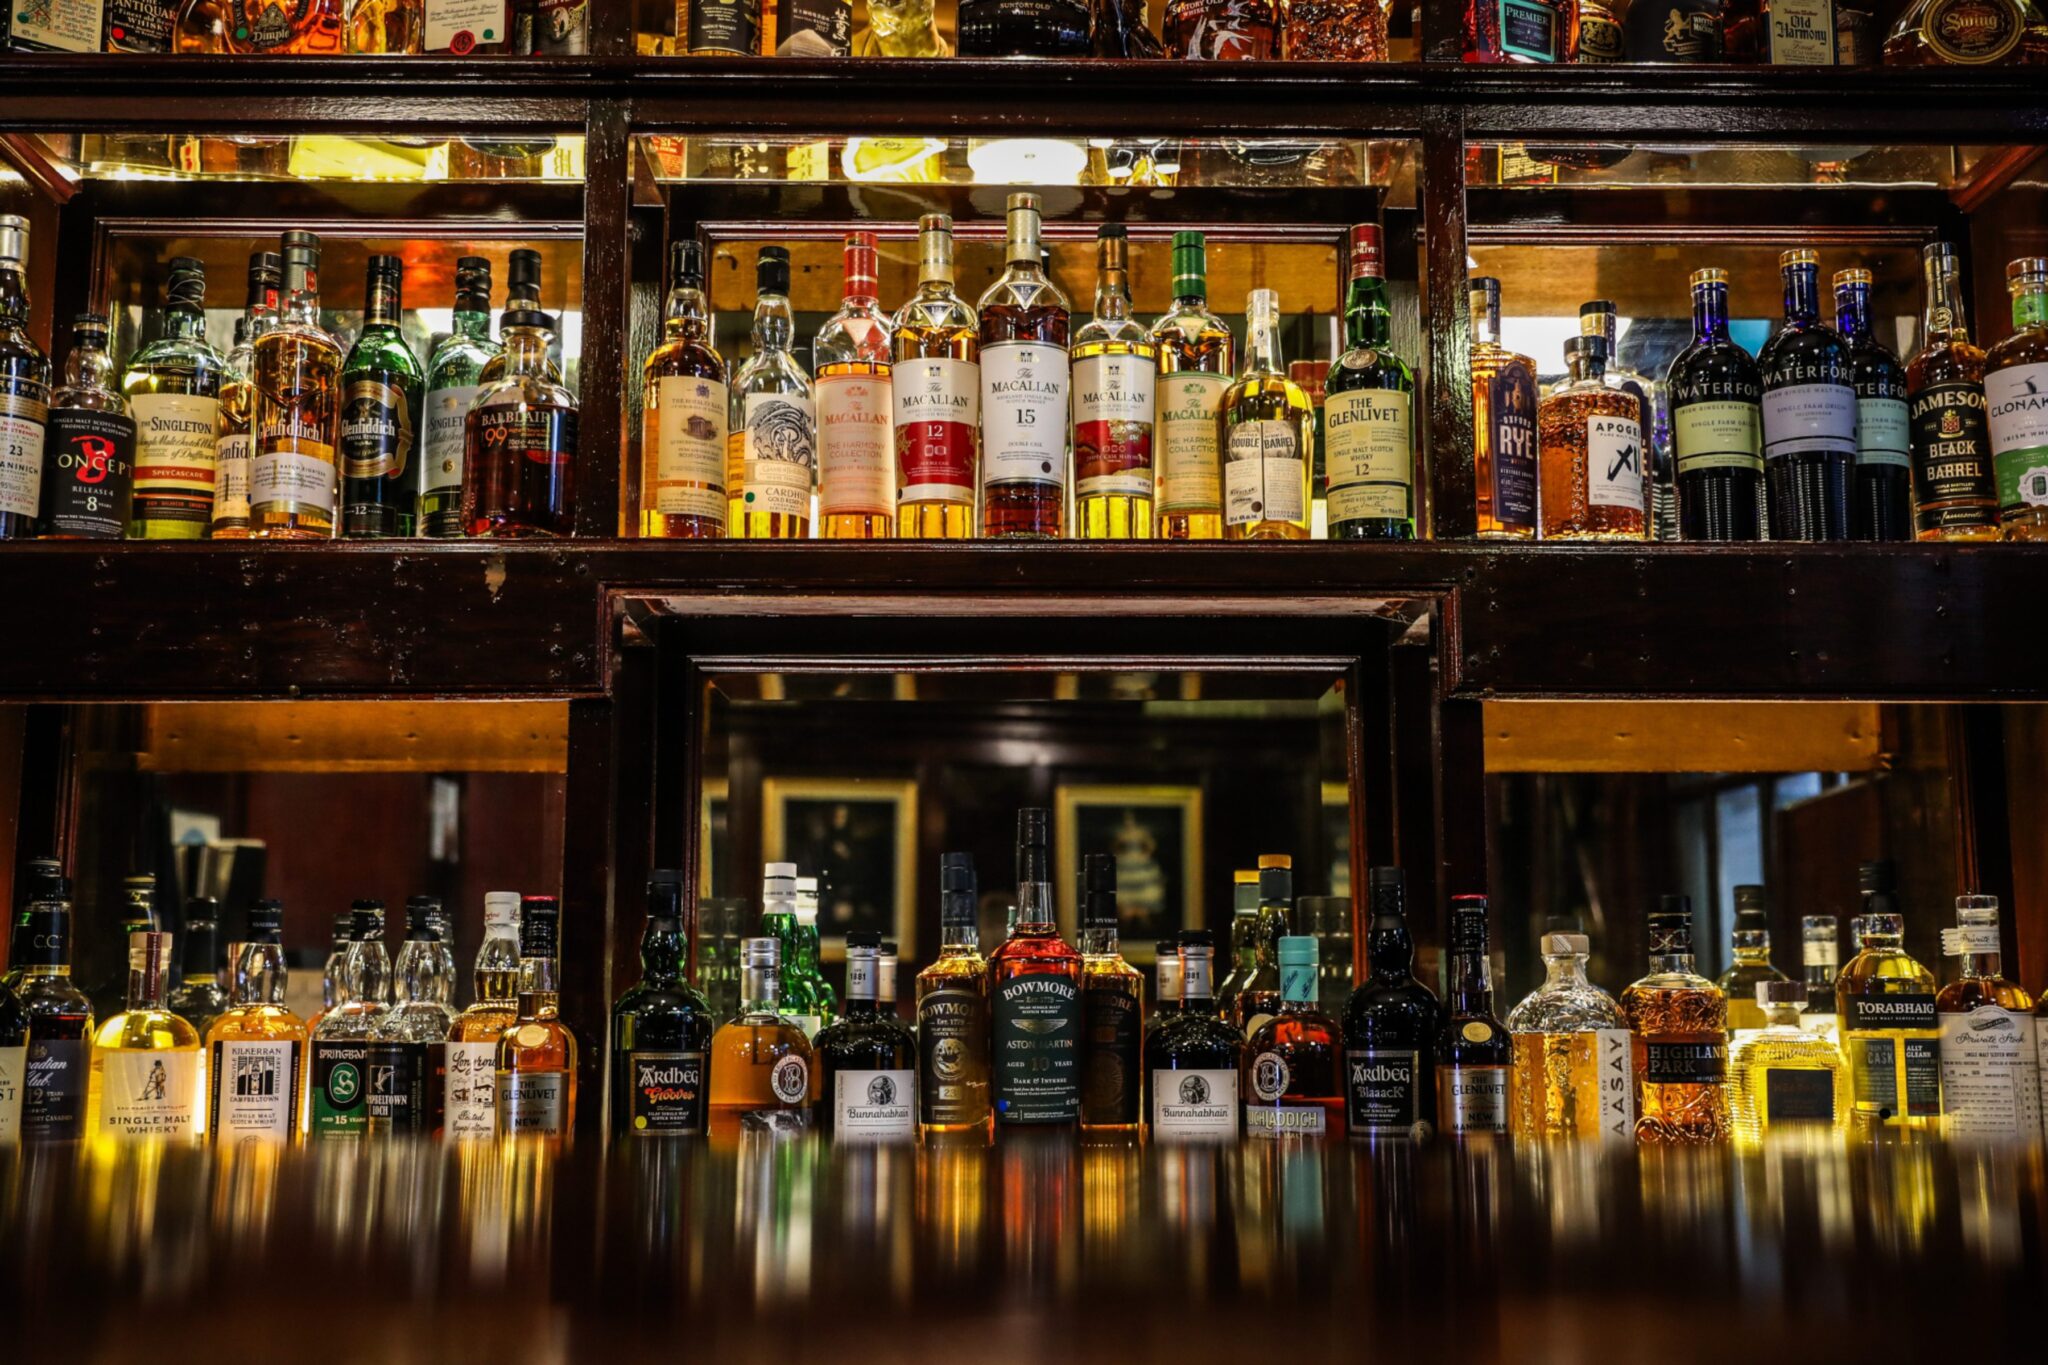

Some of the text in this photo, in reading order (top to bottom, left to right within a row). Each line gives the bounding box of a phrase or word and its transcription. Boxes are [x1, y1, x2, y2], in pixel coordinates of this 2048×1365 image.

[1035, 2, 1051, 10] OLD
[1506, 6, 1549, 25] PREMIER
[1790, 15, 1811, 28] Old
[1941, 12, 1998, 34] Swing
[253, 29, 290, 42] Dimple
[1775, 21, 1827, 46] Harmony
[991, 380, 1060, 395] MACALLAN
[902, 394, 969, 408] MACALLAN
[1083, 391, 1146, 404] MACALLAN
[1348, 397, 1373, 410] THE
[1777, 405, 1802, 413] SINGLE
[1911, 390, 1988, 420] JAMESON
[481, 410, 550, 427] BALBLAIR
[825, 412, 889, 426] MACALLAN
[1016, 408, 1036, 425] 15
[1329, 408, 1399, 429] GLENLIVET
[1502, 415, 1532, 428] OXFORD
[151, 416, 213, 434] SINGLETON
[341, 417, 396, 437] Glenfiddich
[1596, 422, 1641, 437] APOGE
[1691, 420, 1715, 428] SINGLE
[485, 426, 508, 448] 99
[927, 425, 943, 437] 12
[1231, 437, 1260, 448] DOUBLE
[1264, 436, 1294, 449] BARREL
[1500, 425, 1534, 459] RYE
[2003, 433, 2026, 443] IRISH
[9, 444, 23, 457] 23
[842, 441, 886, 449] HARMONY
[1930, 440, 1976, 458] BLACK
[829, 450, 882, 459] COLLECTION
[1333, 446, 1394, 458] SINGLE MALT SCOTCH
[1350, 454, 1374, 462] WHISKY
[1355, 464, 1370, 476] 12
[1927, 462, 1982, 481] BARREL
[72, 485, 108, 495] RELEASE
[765, 487, 805, 499] CARDHU
[86, 496, 98, 512] 8
[355, 506, 367, 515] 12
[1003, 981, 1076, 1001] BOWMORE
[1857, 1001, 1935, 1014] TORABHAIG
[1006, 1040, 1035, 1049] ASTON
[1955, 1031, 2025, 1045] Private Stock
[1868, 1052, 1894, 1065] CASK
[1651, 1060, 1696, 1073] PARK
[230, 1057, 238, 1094] GLENGYLE
[519, 1080, 536, 1088] THE
[1451, 1084, 1505, 1096] GLENLIVET
[28, 1088, 43, 1105] 12
[502, 1088, 557, 1100] GLENLIVET
[644, 1087, 695, 1104] Grooves
[372, 1105, 389, 1115] LOCH
[1162, 1107, 1229, 1119] Bunnahabhain
[109, 1115, 191, 1125] SINGLE MALT
[335, 1115, 348, 1124] 15
[514, 1118, 540, 1127] NEW
[1468, 1113, 1493, 1121] NEW
[126, 1125, 179, 1134] WHISKY
